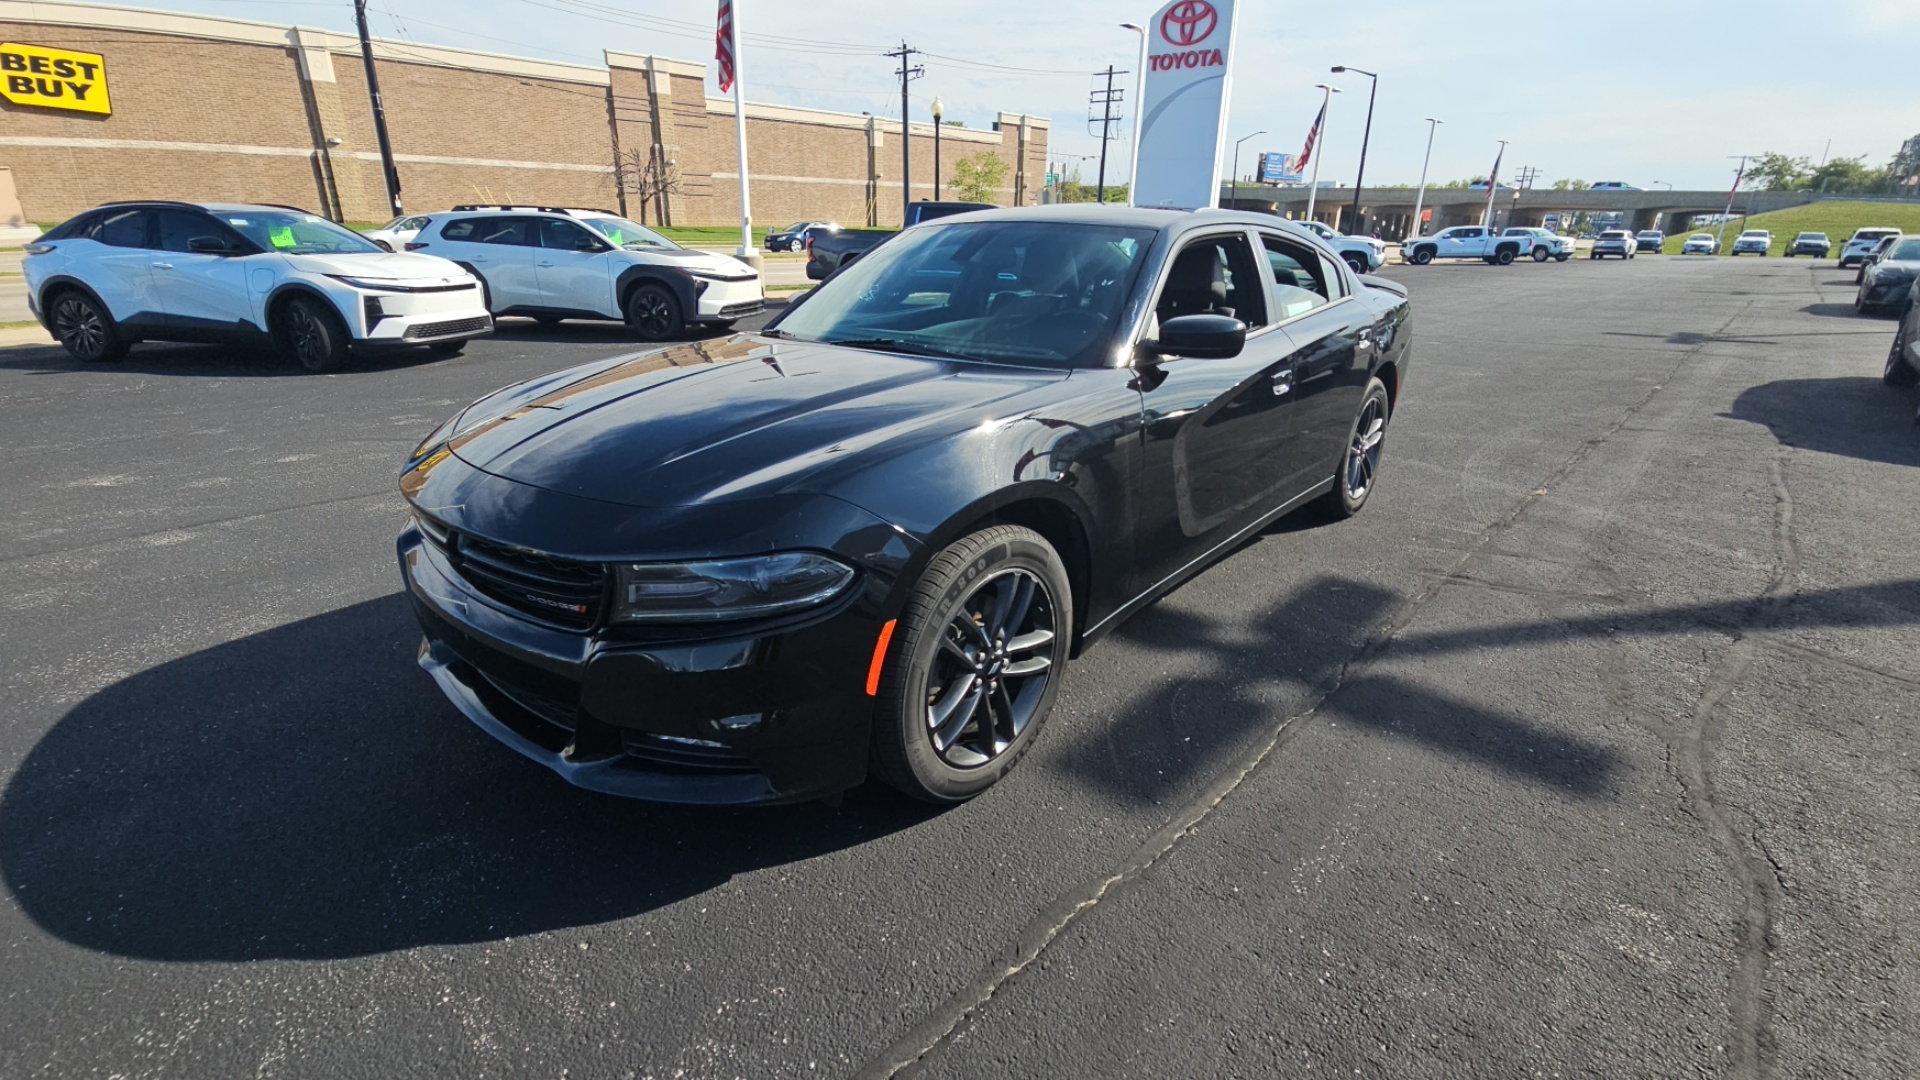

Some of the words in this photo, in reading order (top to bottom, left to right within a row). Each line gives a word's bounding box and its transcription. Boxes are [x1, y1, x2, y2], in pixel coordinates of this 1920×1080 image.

[0, 53, 99, 81] BEST
[1149, 48, 1223, 71] TOYOTA
[7, 75, 93, 101] BUY
[527, 594, 580, 611] DODGE
